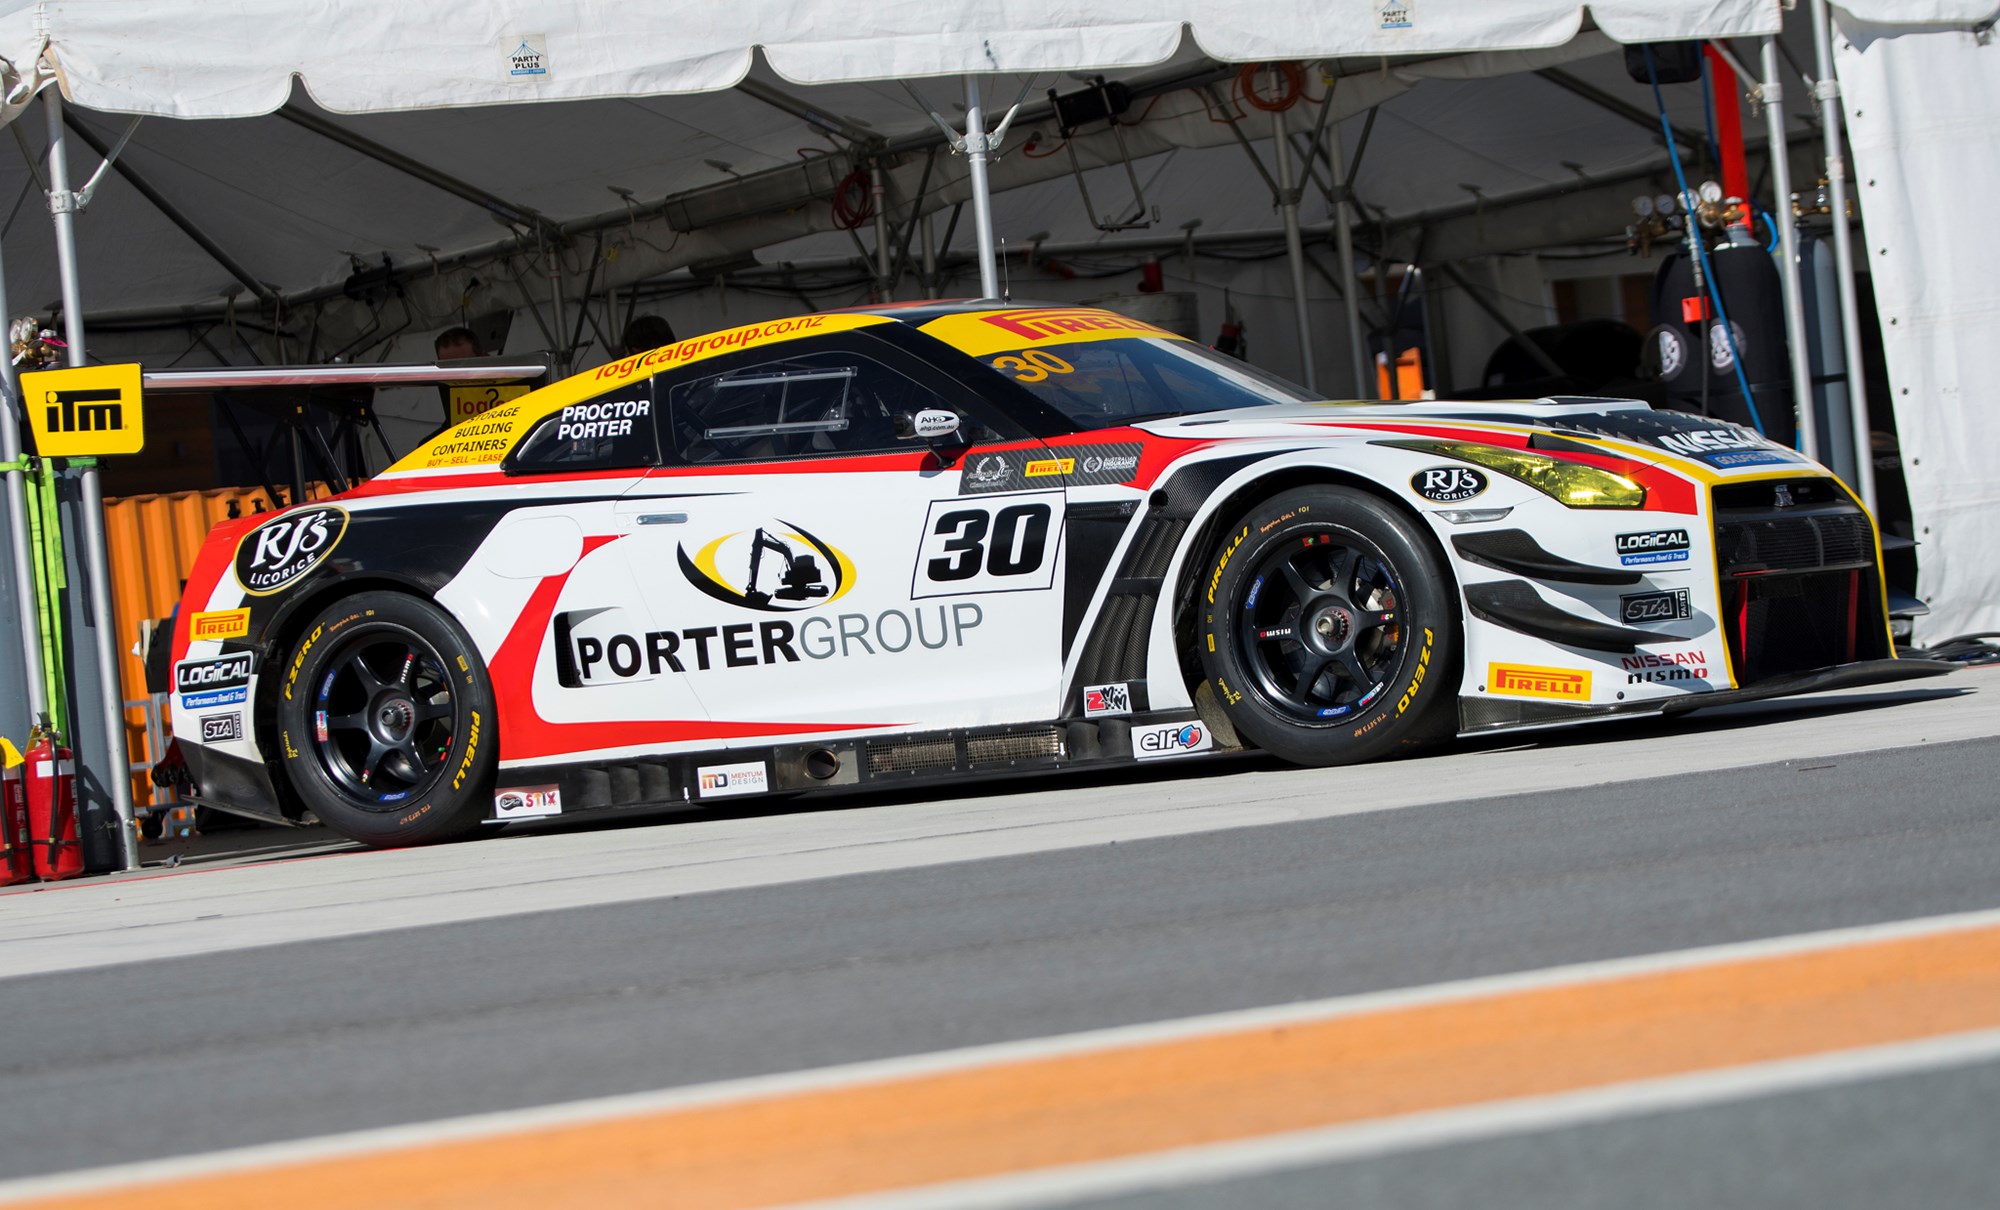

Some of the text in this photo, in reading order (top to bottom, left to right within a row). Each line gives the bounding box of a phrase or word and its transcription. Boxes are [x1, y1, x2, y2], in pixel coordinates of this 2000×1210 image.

[512, 55, 540, 63] PARTY
[992, 349, 1075, 383] 30
[466, 406, 520, 424] STORAGE
[561, 400, 650, 422] PROCTOR
[454, 422, 513, 438] BUILDING
[557, 419, 632, 440] PORTER
[432, 438, 508, 456] CONTAINERS
[426, 459, 443, 467] BUY
[450, 456, 469, 464] SELL
[477, 453, 504, 462] LEASE
[1029, 461, 1070, 474] PIRELLI
[1425, 489, 1475, 500] LICORICE
[927, 503, 1051, 582] 30
[1207, 526, 1248, 604] PIRELLI
[1625, 556, 1655, 564] Performance
[1673, 552, 1687, 560] Track
[250, 552, 316, 585] LICORICE
[1626, 597, 1672, 619] STA
[1679, 592, 1688, 617] PARTS
[196, 614, 245, 635] PIRELLI
[1260, 628, 1291, 638] nismo
[576, 602, 983, 679] PORTERGROUP
[284, 626, 322, 700] PZERO
[400, 653, 414, 684] nismo
[1398, 627, 1433, 713] PZERO
[1621, 650, 1706, 670] NISSAN
[1496, 668, 1583, 694] PIRELLI
[1627, 667, 1708, 685] nismo
[185, 696, 218, 707] Performance
[235, 690, 246, 700] Track
[204, 719, 234, 739] STA
[1141, 729, 1182, 751] elf
[453, 711, 480, 790] PIRELLI
[730, 771, 763, 779] MENTUM
[731, 776, 764, 785] DESIGN
[526, 792, 556, 808] STIX
